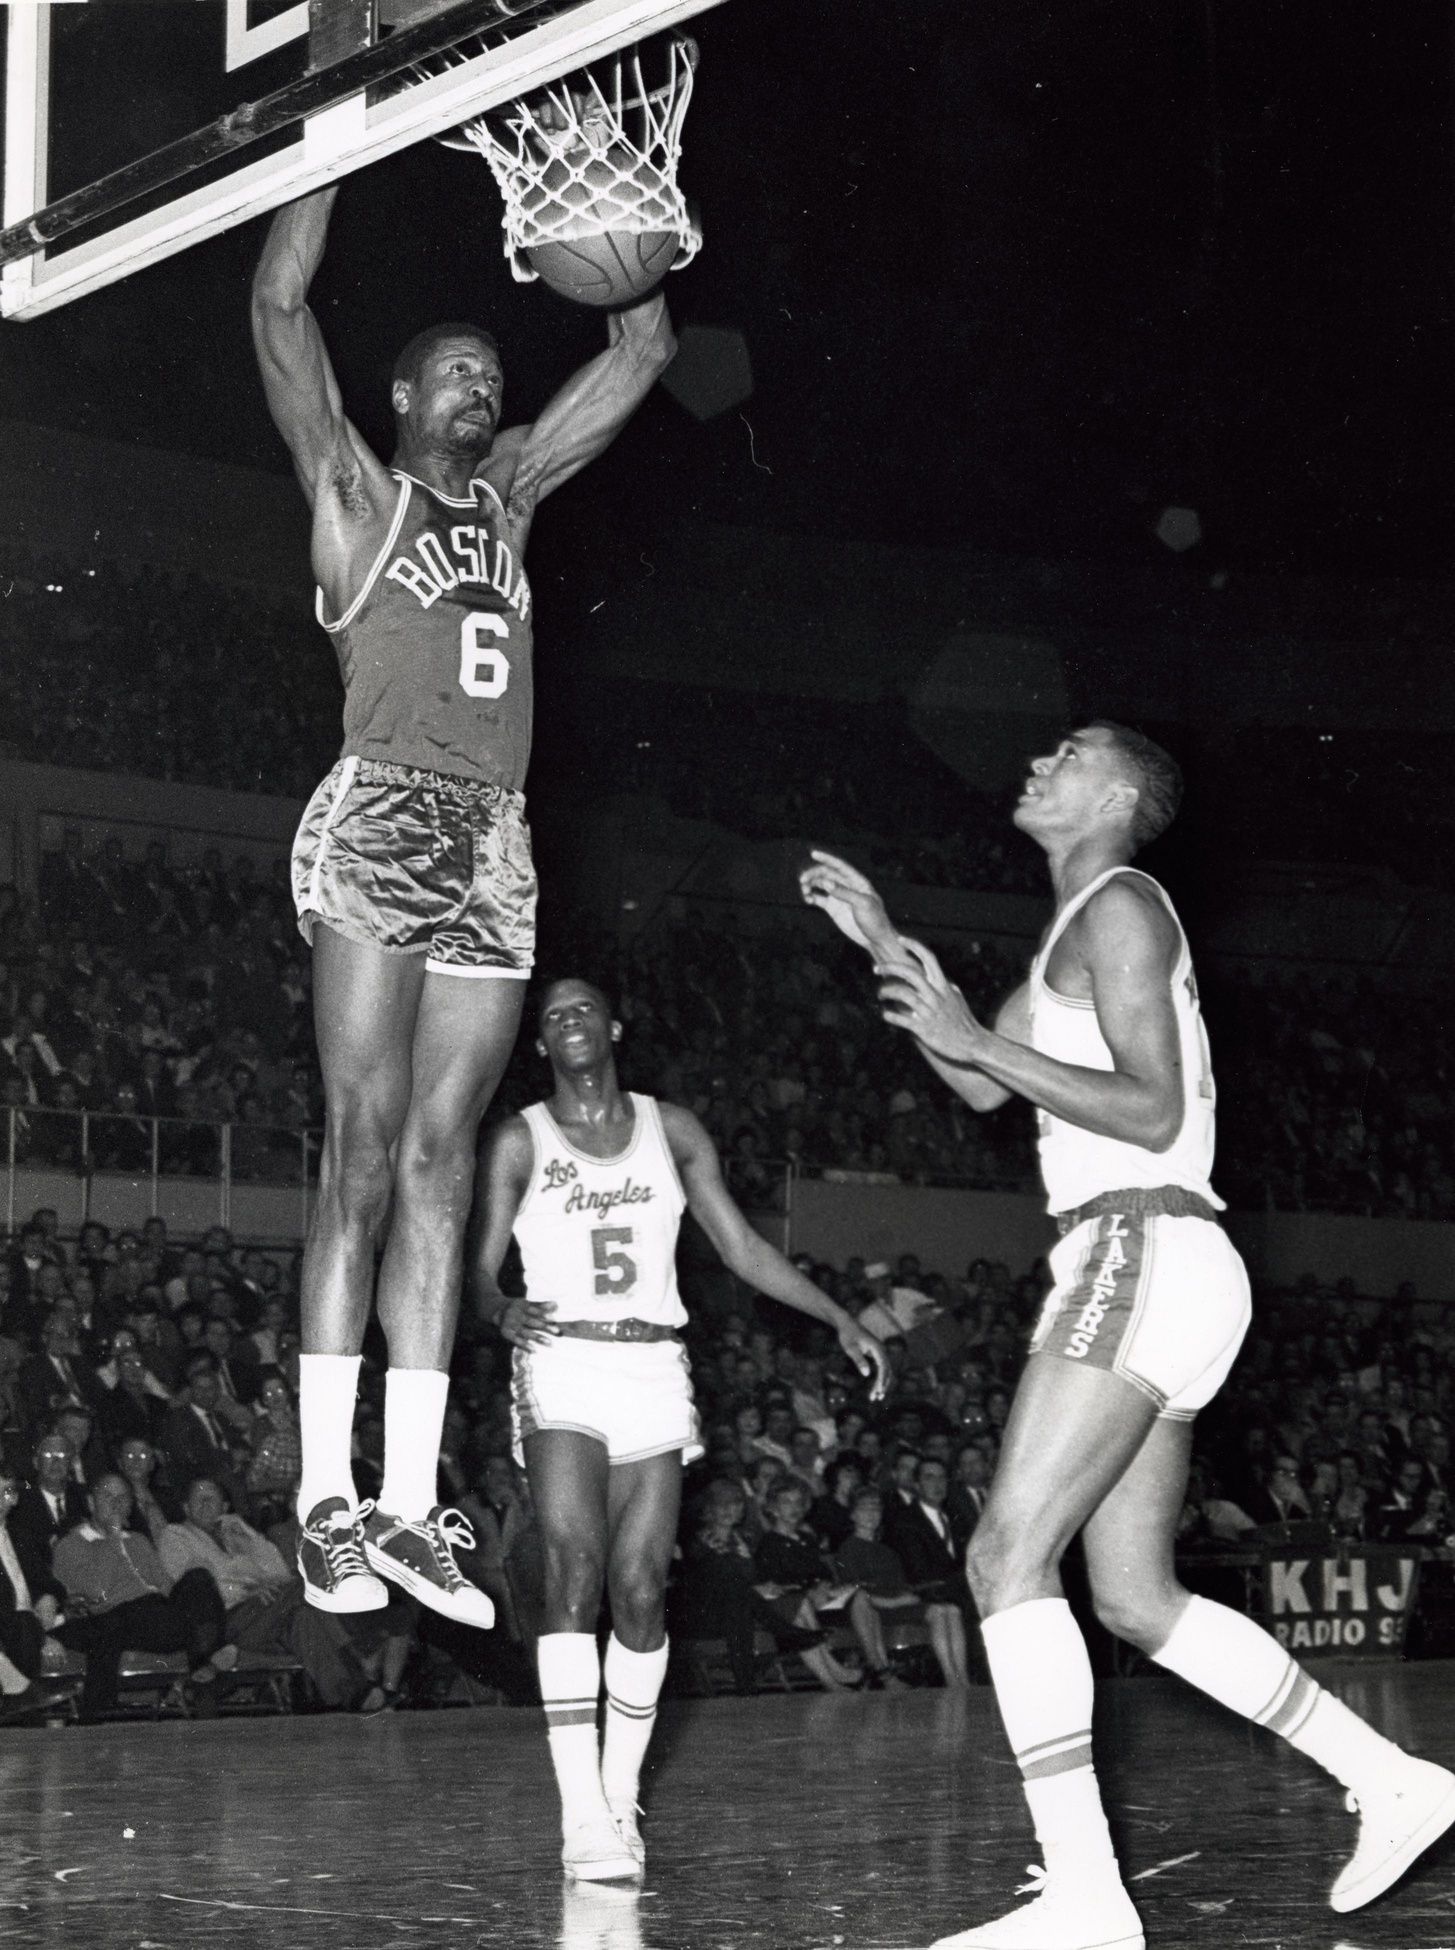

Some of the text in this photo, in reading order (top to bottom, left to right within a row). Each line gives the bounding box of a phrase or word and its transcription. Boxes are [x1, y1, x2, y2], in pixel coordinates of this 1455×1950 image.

[459, 611, 510, 699] 6
[541, 1159, 578, 1193] Los
[565, 1177, 656, 1219] Angeles
[591, 1227, 637, 1295] 5
[1064, 1214, 1129, 1358] LAKERS
[1270, 1558, 1414, 1614] KHJ
[1274, 1618, 1366, 1648] RADIO
